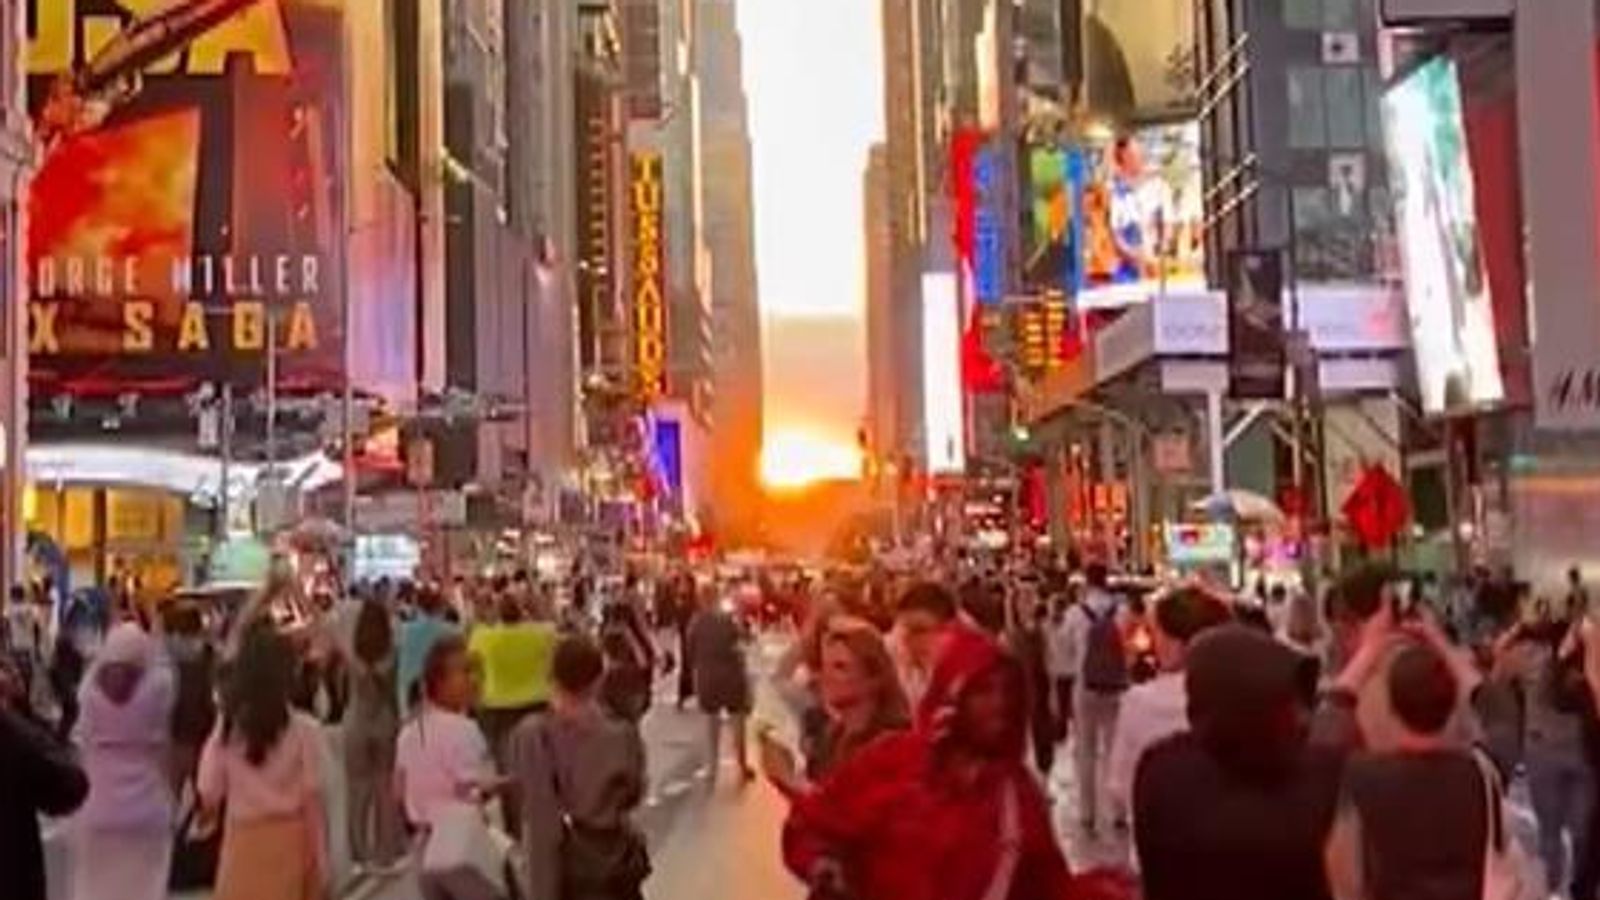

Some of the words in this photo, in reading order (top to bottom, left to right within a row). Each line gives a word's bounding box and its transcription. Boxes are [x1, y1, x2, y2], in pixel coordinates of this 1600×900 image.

[26, 0, 292, 75] SA
[171, 255, 318, 294] MILLER
[122, 300, 317, 350] SAGA
